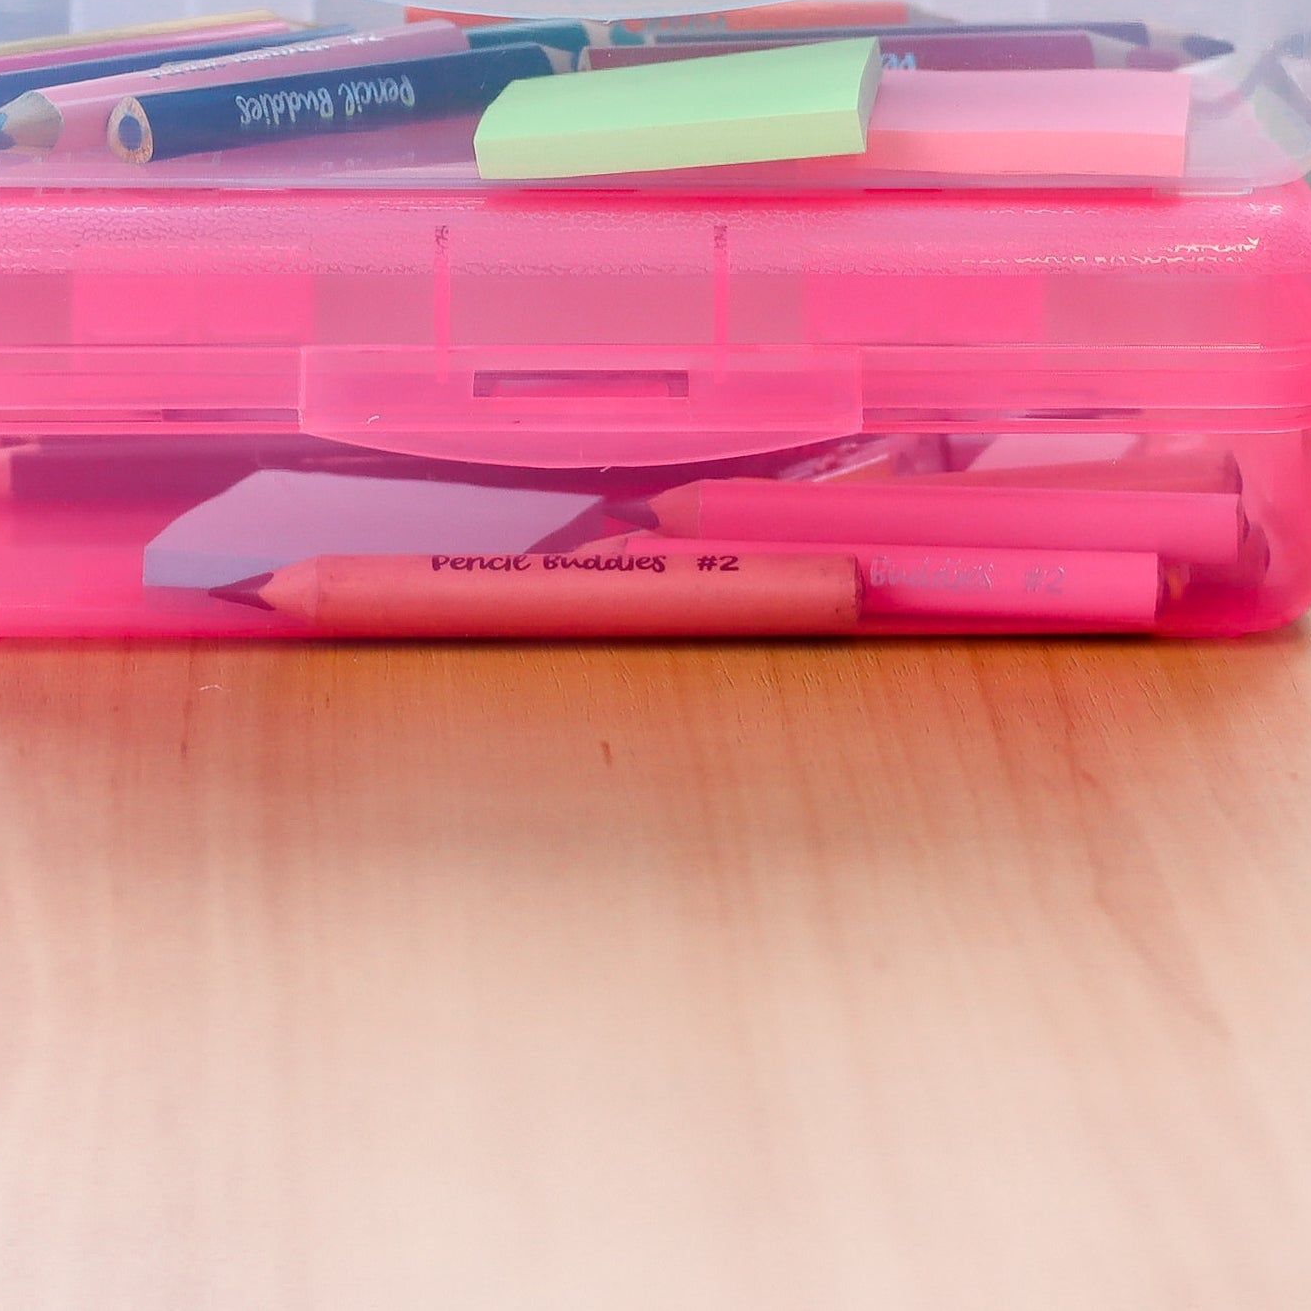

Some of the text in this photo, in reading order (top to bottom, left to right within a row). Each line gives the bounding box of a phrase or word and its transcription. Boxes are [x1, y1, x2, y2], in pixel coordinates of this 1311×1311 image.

[235, 74, 416, 125] Pencil Buddies
[696, 554, 740, 572] #2
